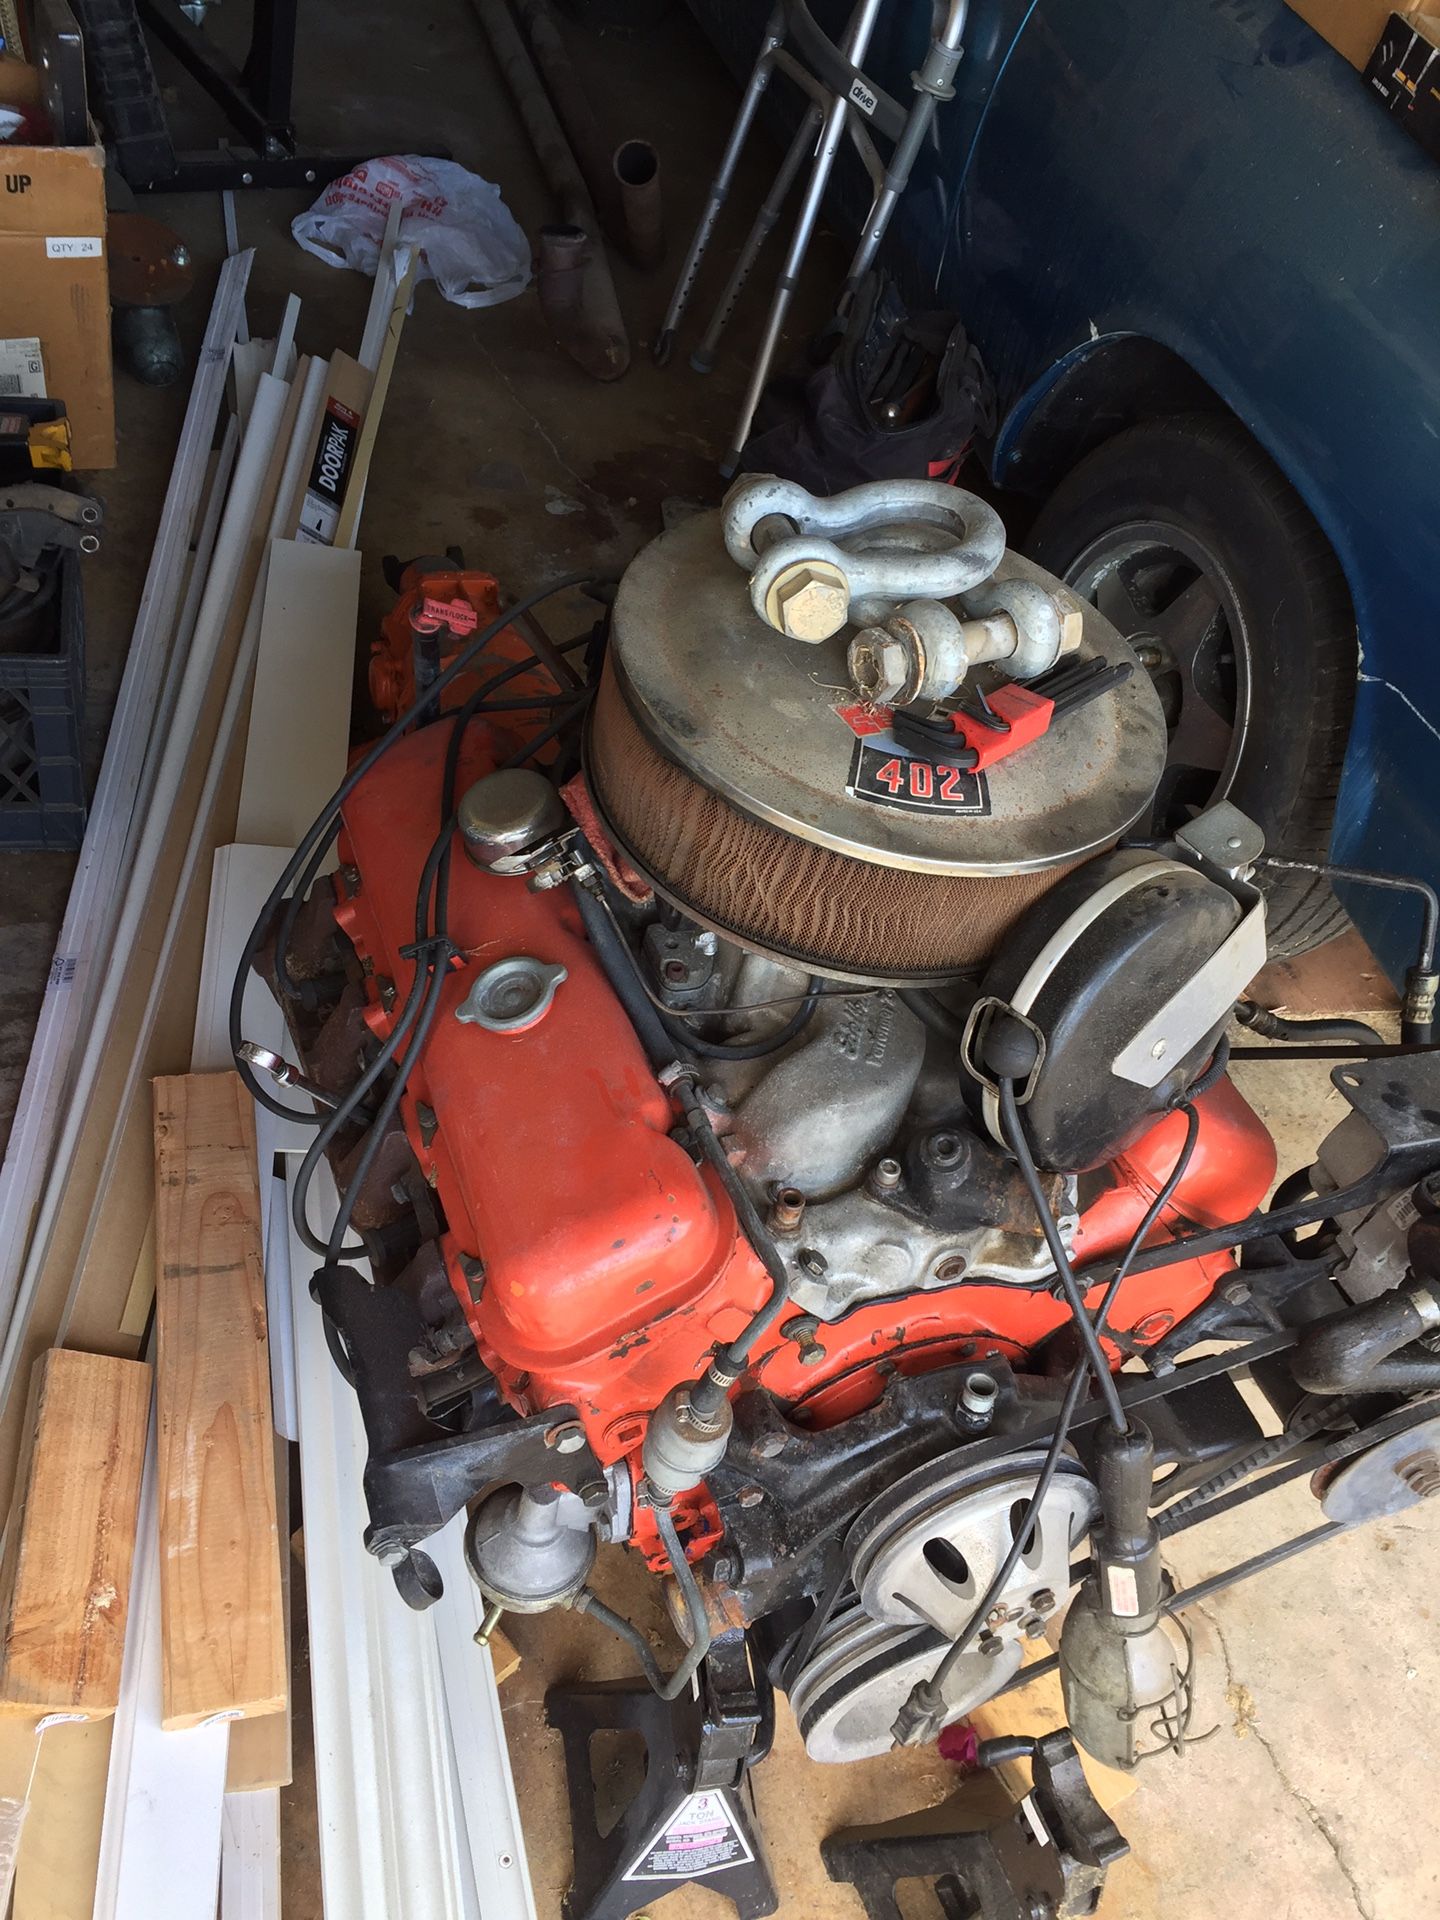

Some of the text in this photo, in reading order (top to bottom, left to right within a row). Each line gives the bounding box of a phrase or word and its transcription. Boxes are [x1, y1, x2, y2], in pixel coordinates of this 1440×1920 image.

[852, 86, 874, 108] drive
[5, 174, 31, 193] UP
[51, 243, 93, 253] QTY 24
[319, 421, 349, 492] DOORPAK
[876, 758, 964, 802] 402
[697, 1797, 708, 1809] 3
[688, 1809, 714, 1820] TON
